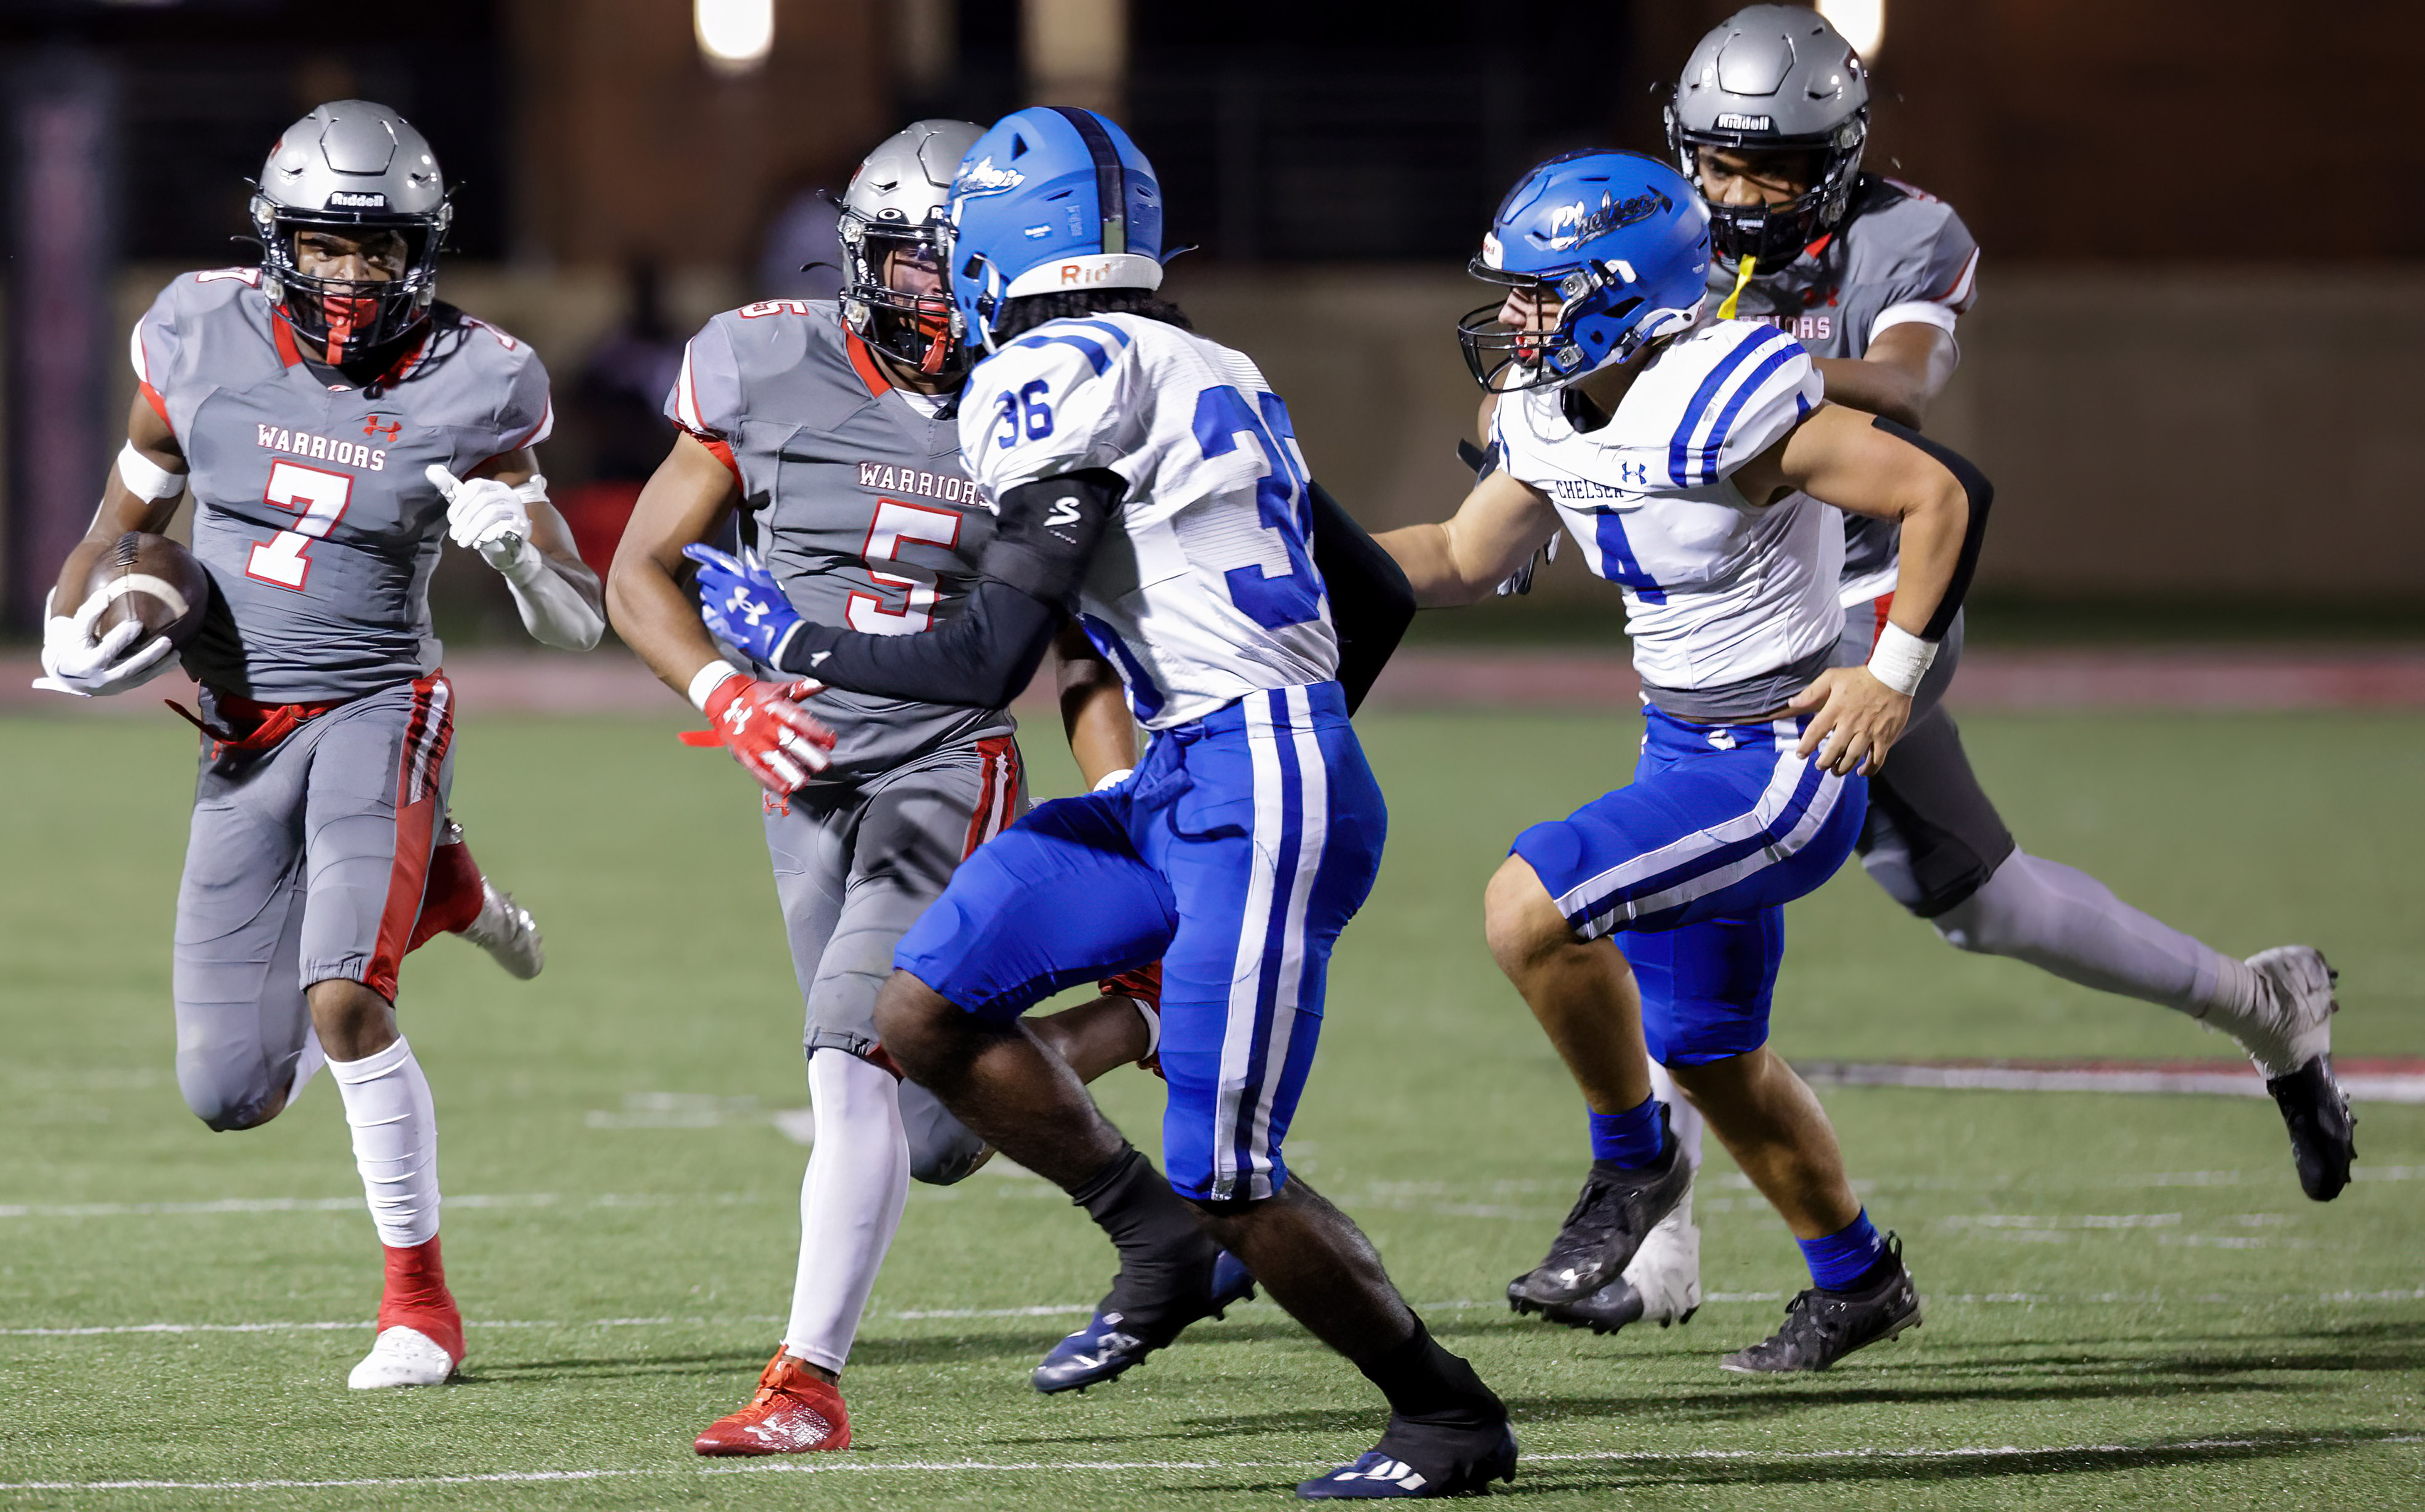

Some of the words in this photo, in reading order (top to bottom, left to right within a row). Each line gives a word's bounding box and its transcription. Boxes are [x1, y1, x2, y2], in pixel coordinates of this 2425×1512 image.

[331, 192, 384, 206] Riddell
[258, 424, 386, 471] WARRIORS
[993, 379, 1054, 449] 36
[245, 458, 355, 591] 7
[845, 497, 963, 637] 5
[1596, 505, 1667, 606] 4
